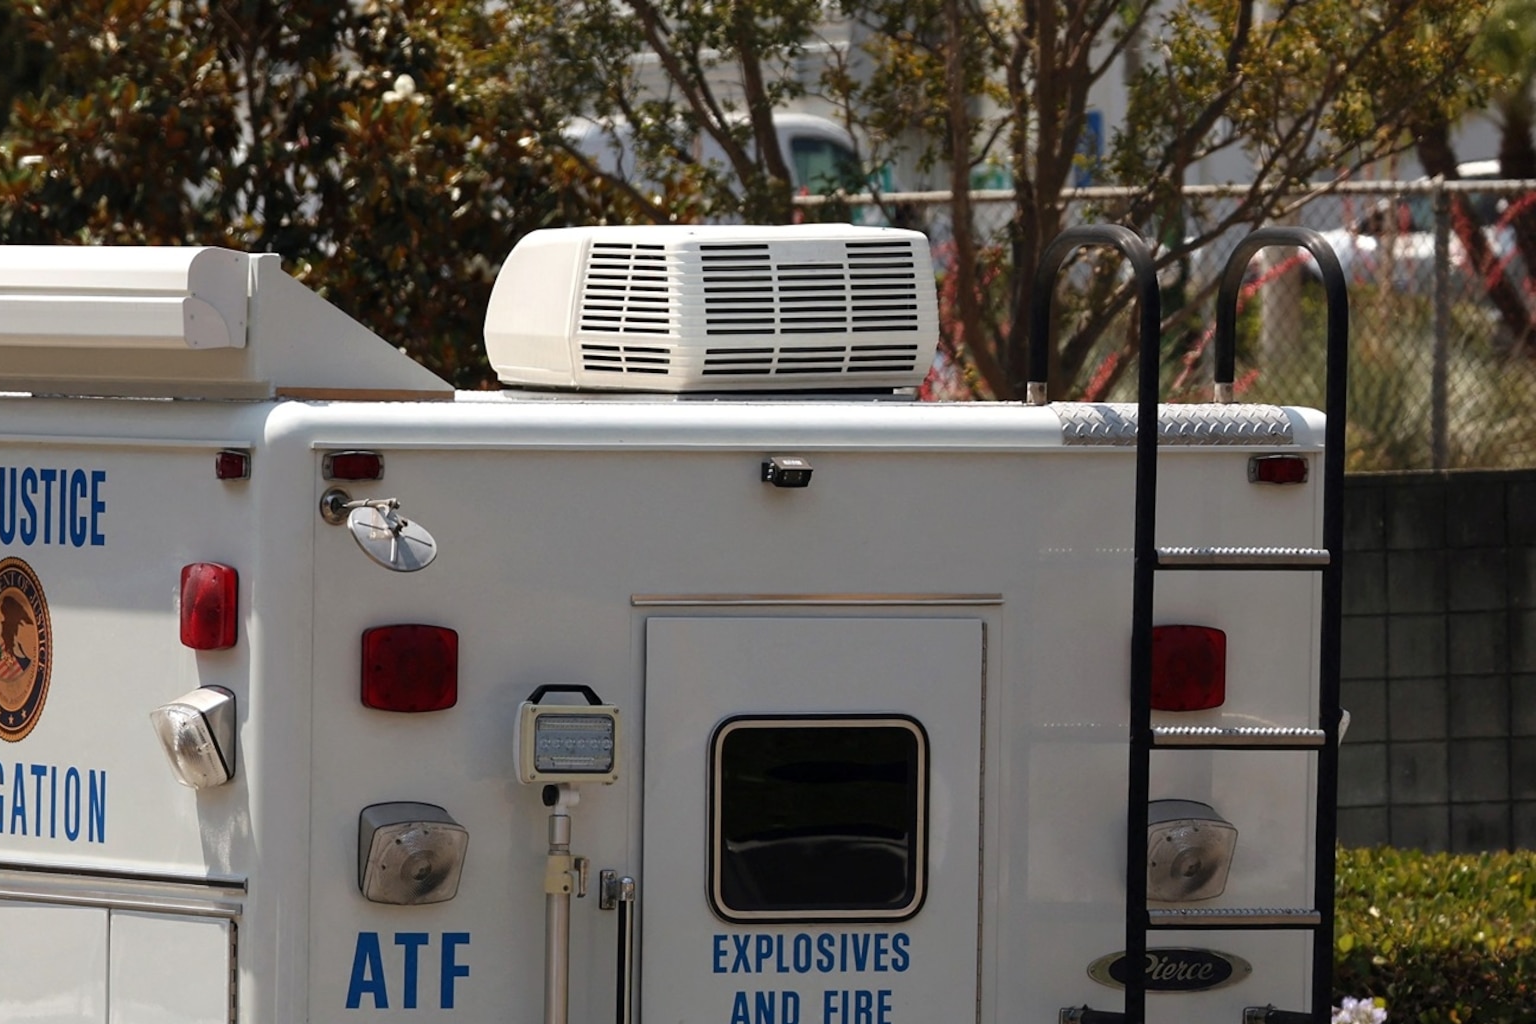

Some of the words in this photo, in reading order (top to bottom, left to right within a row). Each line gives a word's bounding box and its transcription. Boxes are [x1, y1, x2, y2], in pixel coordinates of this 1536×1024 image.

[345, 931, 470, 1009] ATF
[713, 933, 911, 974] EXPLOSIVES
[1145, 953, 1215, 981] Pierce
